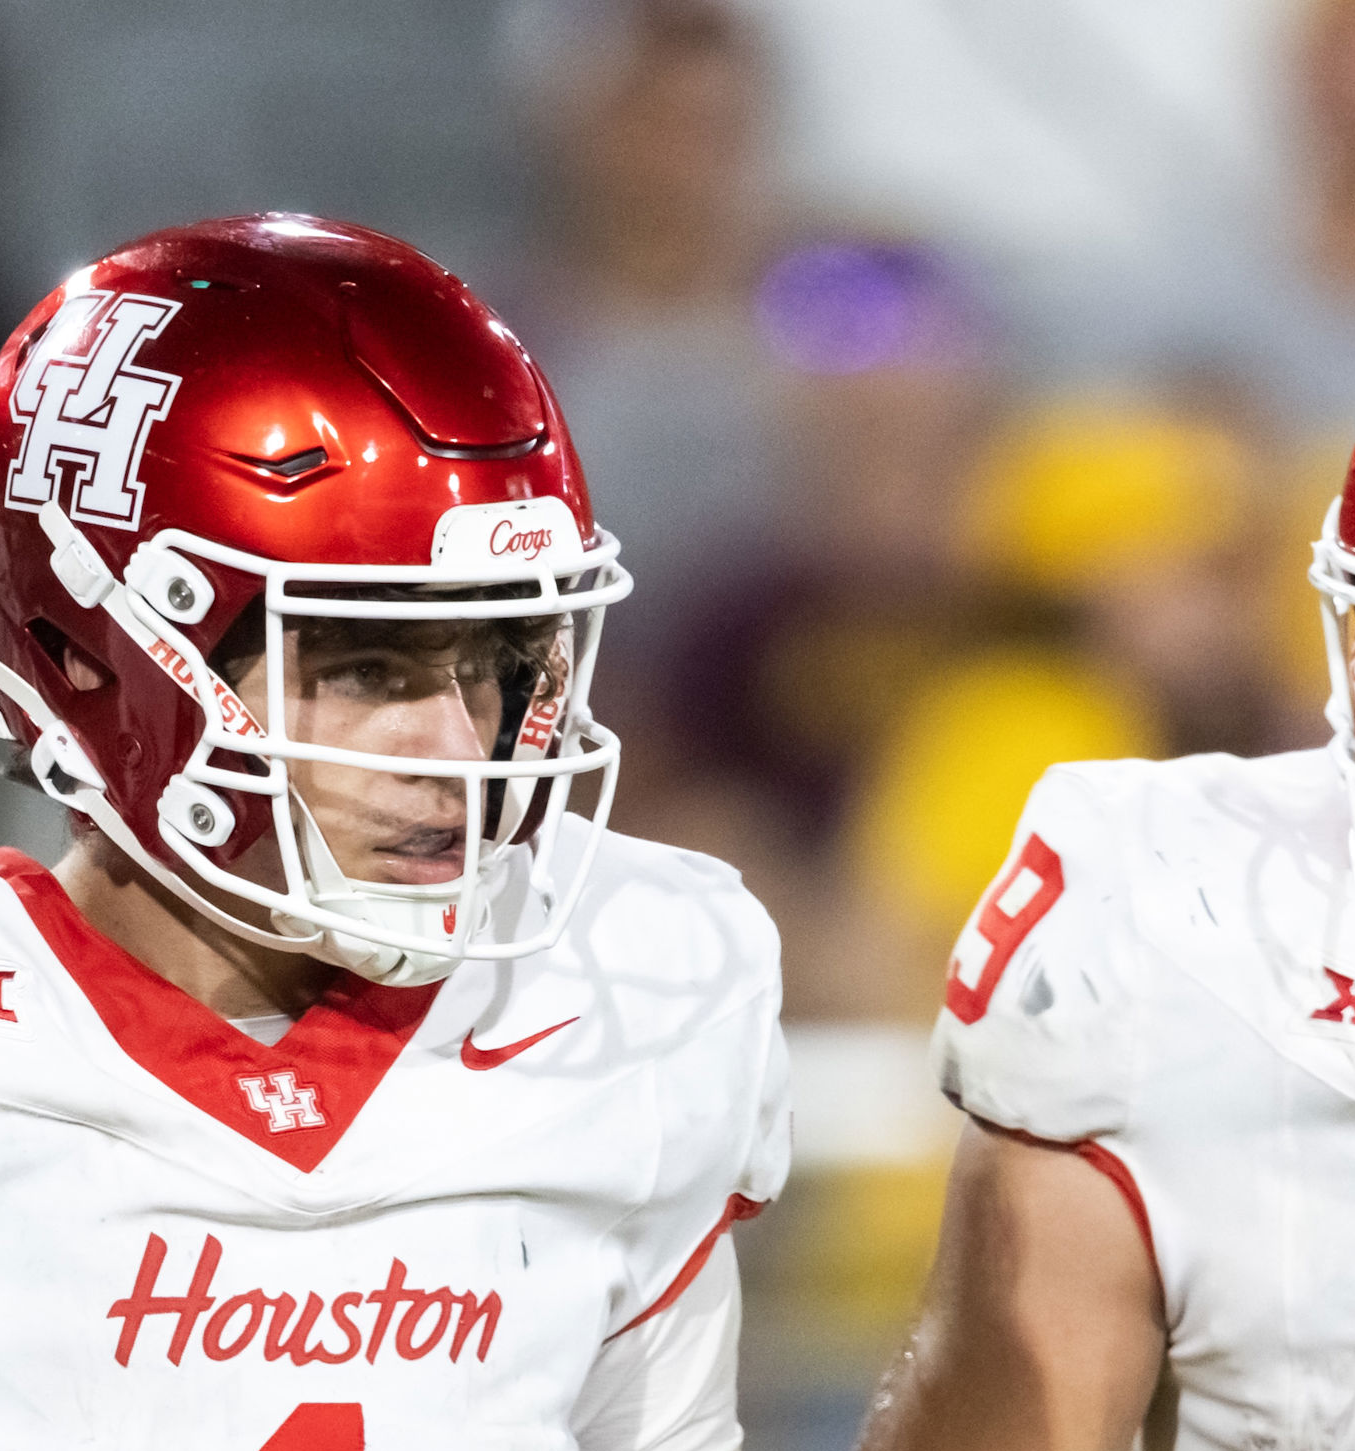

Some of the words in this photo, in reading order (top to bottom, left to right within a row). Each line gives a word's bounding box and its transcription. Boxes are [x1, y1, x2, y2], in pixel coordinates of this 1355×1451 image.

[489, 519, 552, 561] Coogs
[945, 832, 1065, 1026] 9
[238, 1072, 326, 1133] UH
[106, 1232, 503, 1368] Houston
